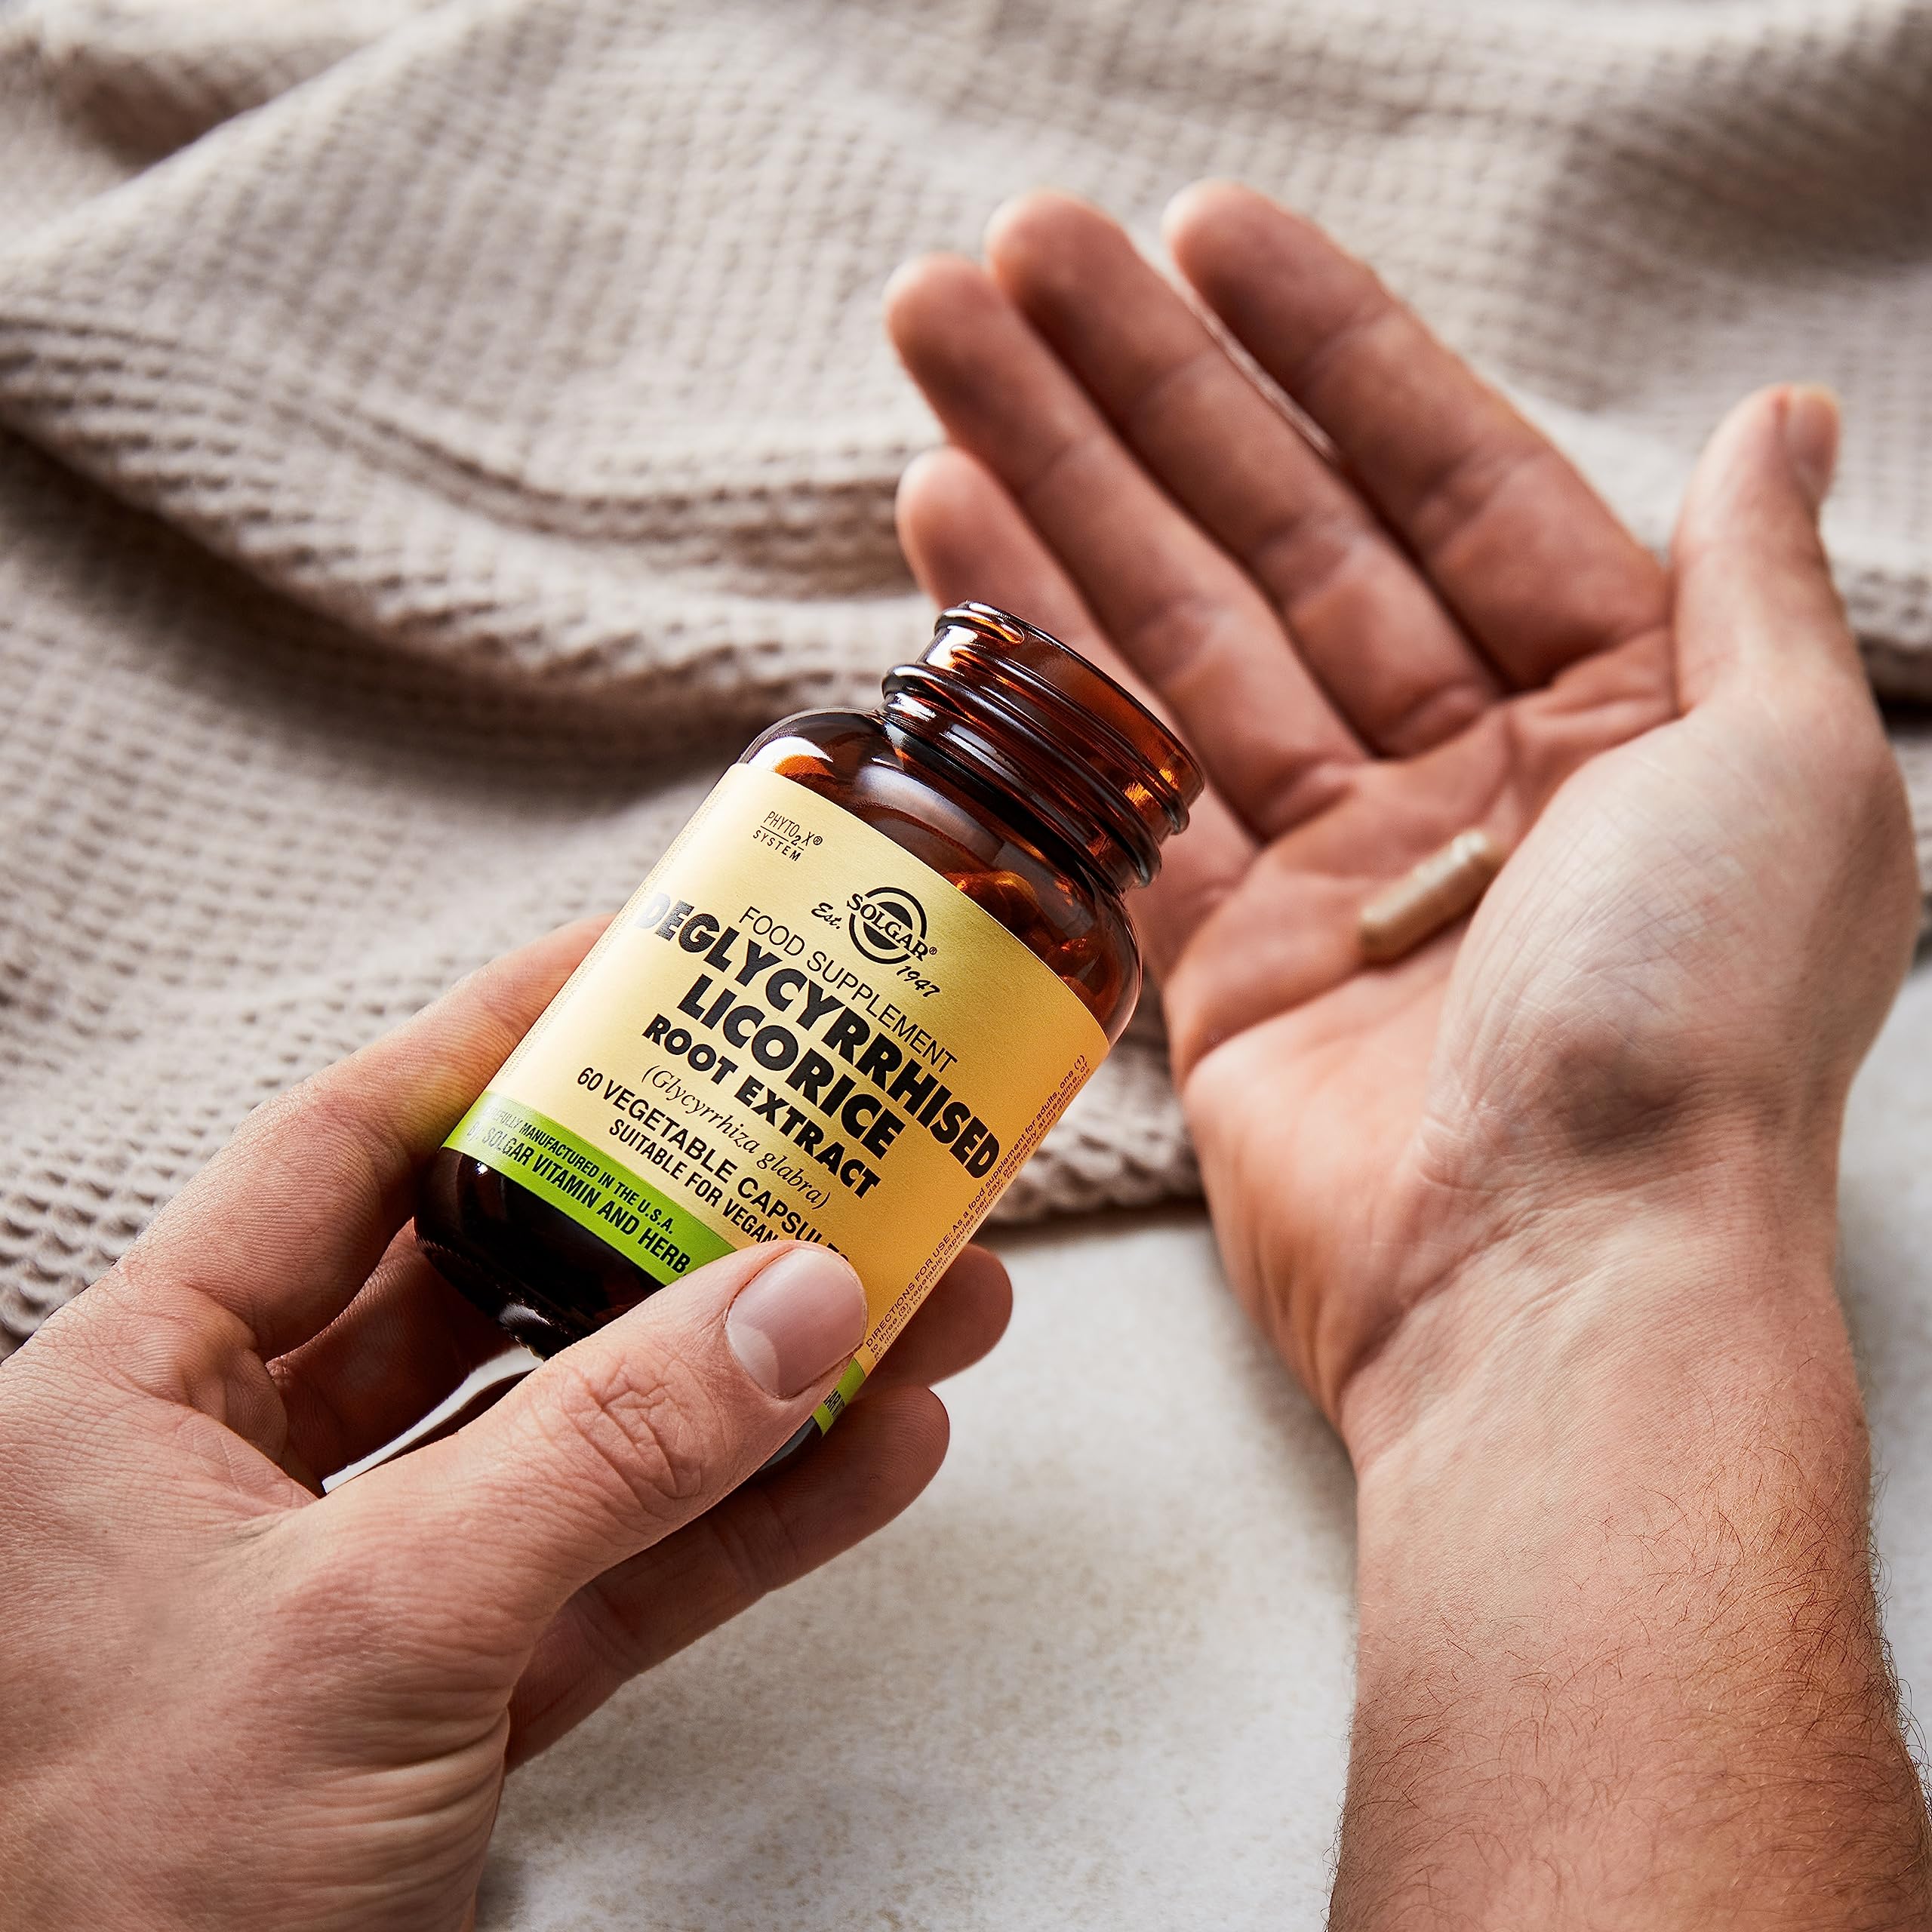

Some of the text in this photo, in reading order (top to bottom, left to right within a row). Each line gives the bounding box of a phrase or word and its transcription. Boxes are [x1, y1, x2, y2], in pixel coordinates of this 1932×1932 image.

[753, 830, 801, 861] SYSTEM
[739, 906, 805, 956] FOOD
[807, 951, 958, 1072] SUPPLEMENT
[811, 903, 940, 997] Est. 1947
[634, 893, 1000, 1179] DEGLYCYRRHISED
[641, 1014, 881, 1198] ROOT EXTRACT
[677, 974, 906, 1160] LICORICE
[483, 1127, 534, 1166] SOLGAR
[531, 1154, 601, 1208] VITAMIN
[596, 1202, 640, 1235] AND
[637, 1227, 691, 1276] HERB
[519, 1122, 600, 1178] MANUFACTURED
[598, 1172, 615, 1189] IN
[613, 1182, 640, 1206] THE
[637, 1199, 674, 1234] U.S.A.
[577, 1067, 848, 1263] 60 VEGETABLE CAPSU
[609, 1118, 688, 1180] SUITABLE
[684, 1171, 723, 1208] FOR
[641, 1066, 830, 1210] (Glycyrrhiza glabra)
[866, 1283, 914, 1346] DIRECTIONS
[915, 1259, 932, 1281] FOR
[933, 1232, 952, 1257] USE:
[951, 1218, 961, 1232] As
[968, 1189, 984, 1209] food
[985, 1135, 1025, 1188] supplement
[1025, 1118, 1036, 1134] for
[1060, 1071, 1073, 1088] one
[878, 1318, 897, 1340] three
[909, 1257, 943, 1300] vegetable
[943, 1215, 974, 1254] capsules
[974, 1197, 987, 1214] per
[1002, 1131, 1037, 1176] preferably
[1037, 1118, 1045, 1129] at
